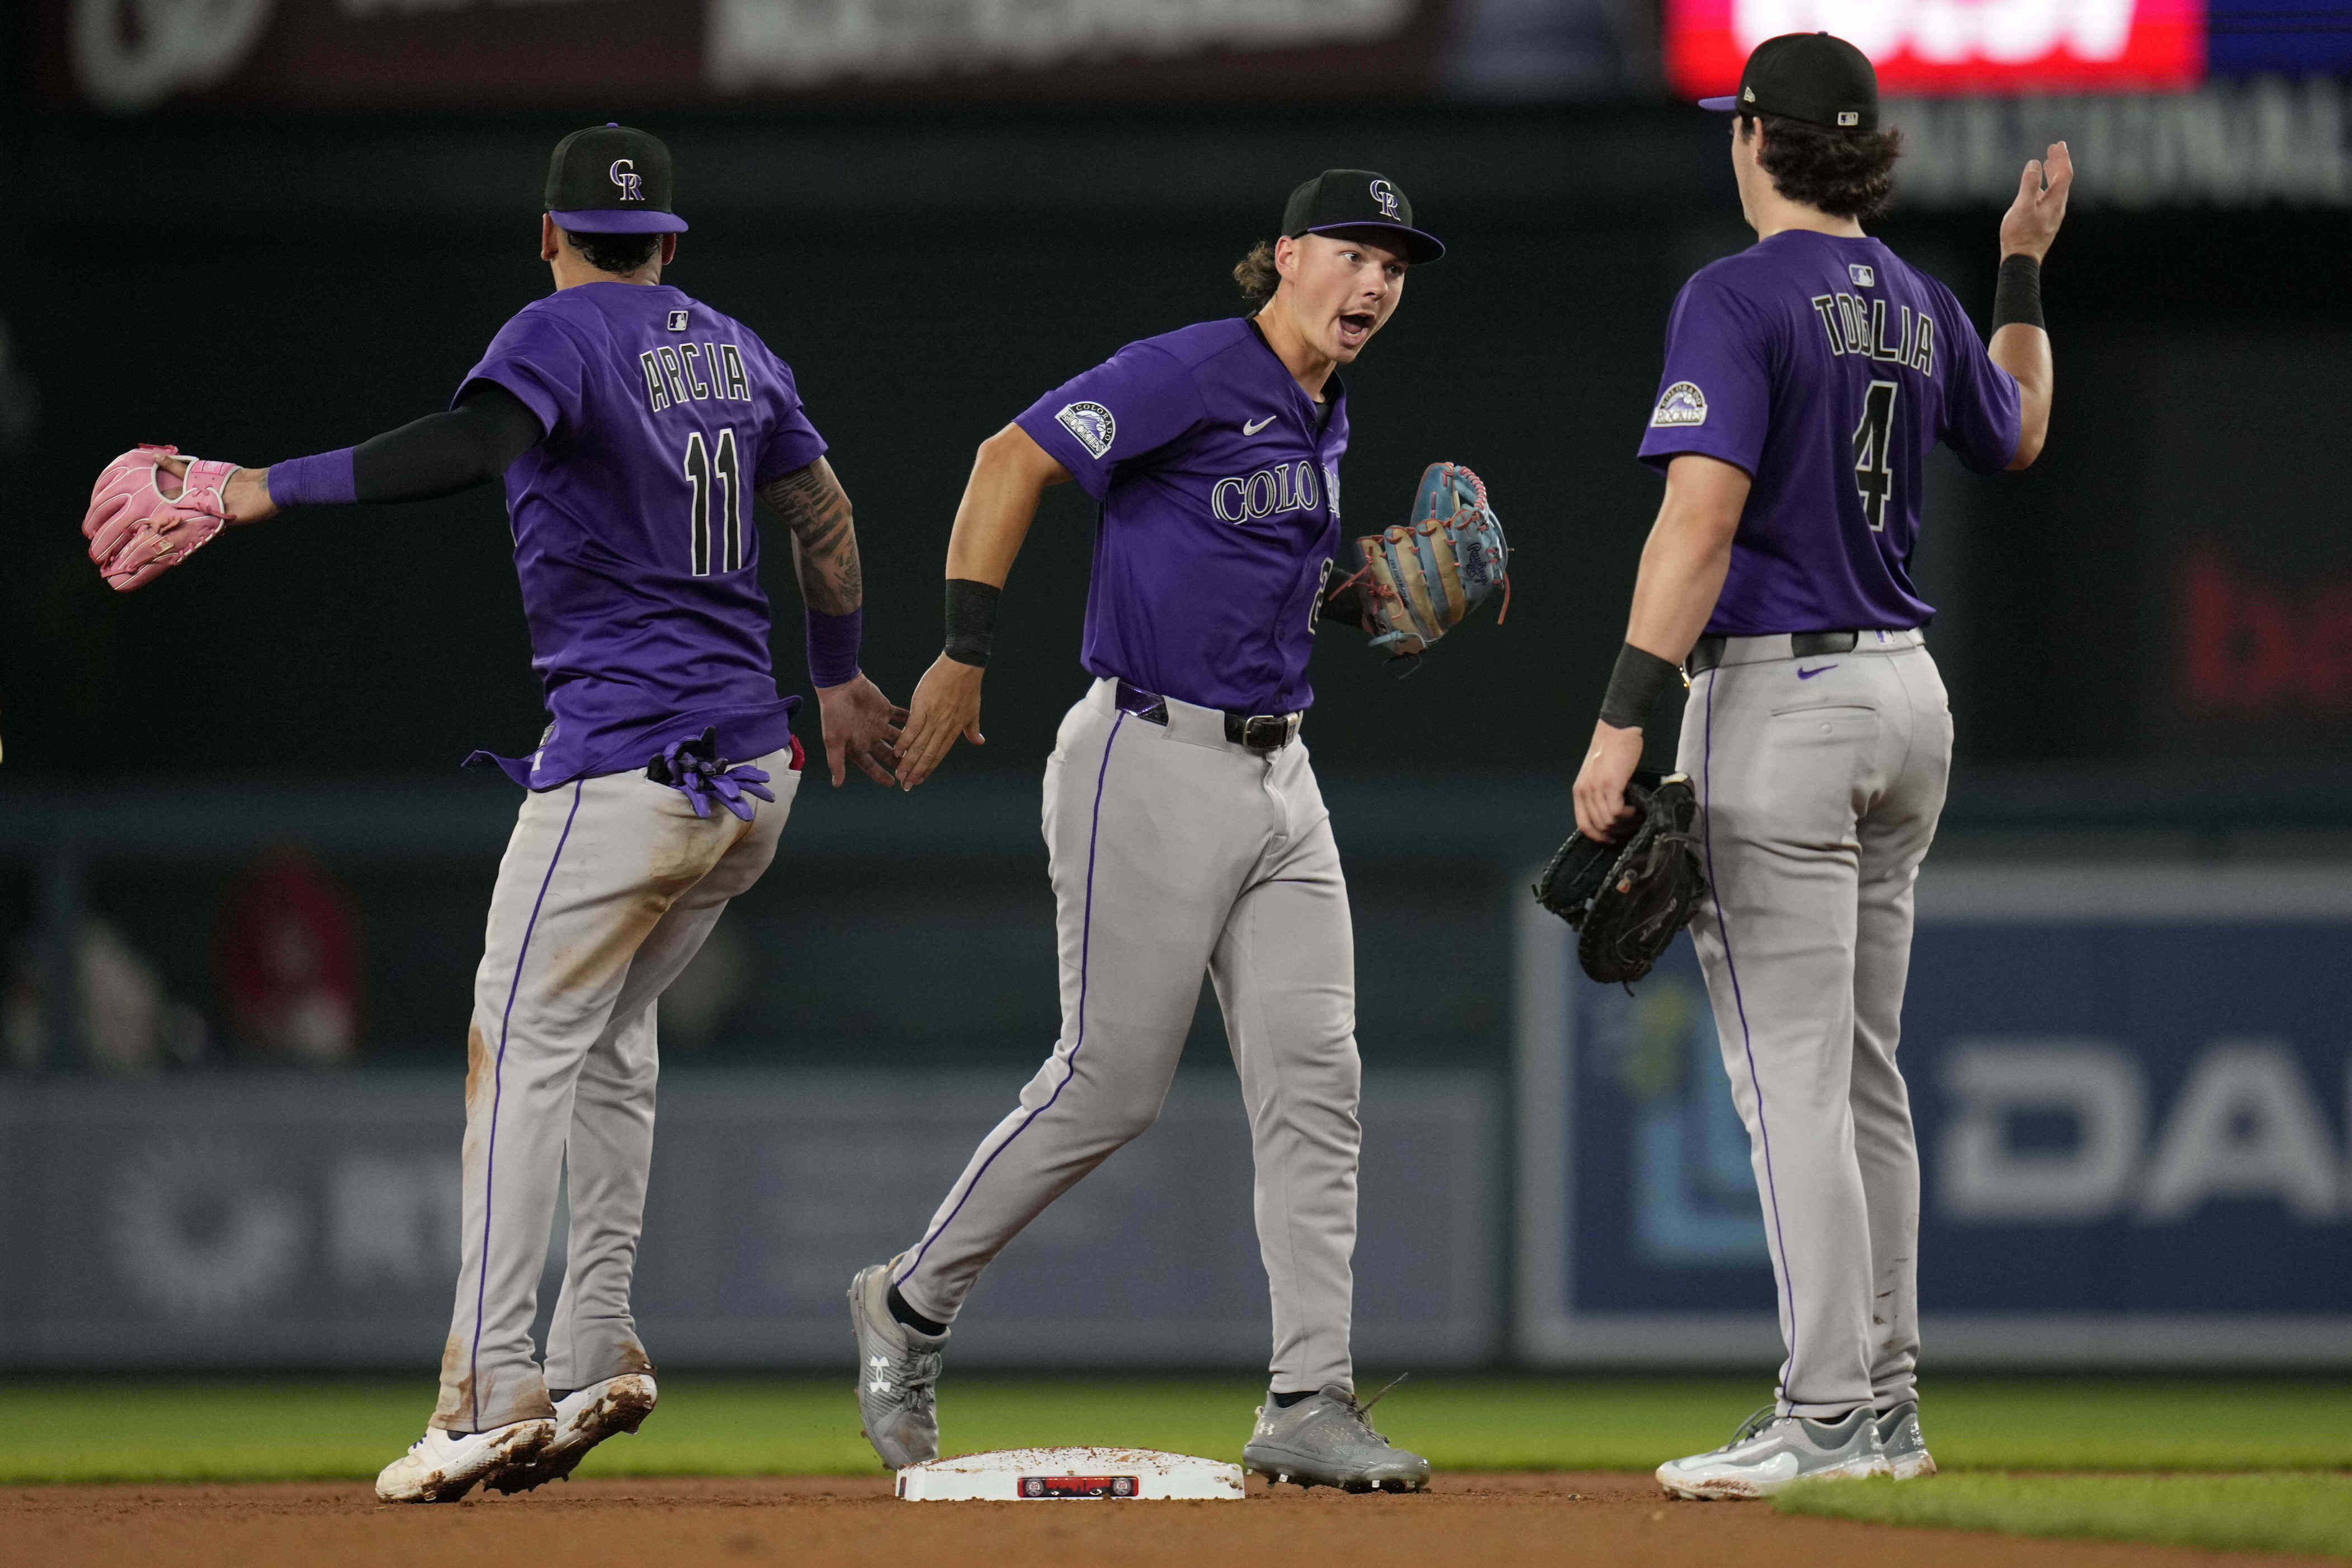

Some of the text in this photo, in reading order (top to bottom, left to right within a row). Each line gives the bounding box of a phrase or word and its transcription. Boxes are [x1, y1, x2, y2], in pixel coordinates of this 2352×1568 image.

[610, 159, 645, 201] CR
[1370, 180, 1401, 221] CR
[1811, 292, 1934, 377] TOGLIA
[640, 342, 752, 413] ARCIA
[1060, 409, 1106, 454] ROCKIES
[1075, 404, 1113, 441] COLORADO
[1852, 380, 1898, 532] 4
[683, 427, 742, 577] 11
[1211, 460, 1340, 525] COLO
